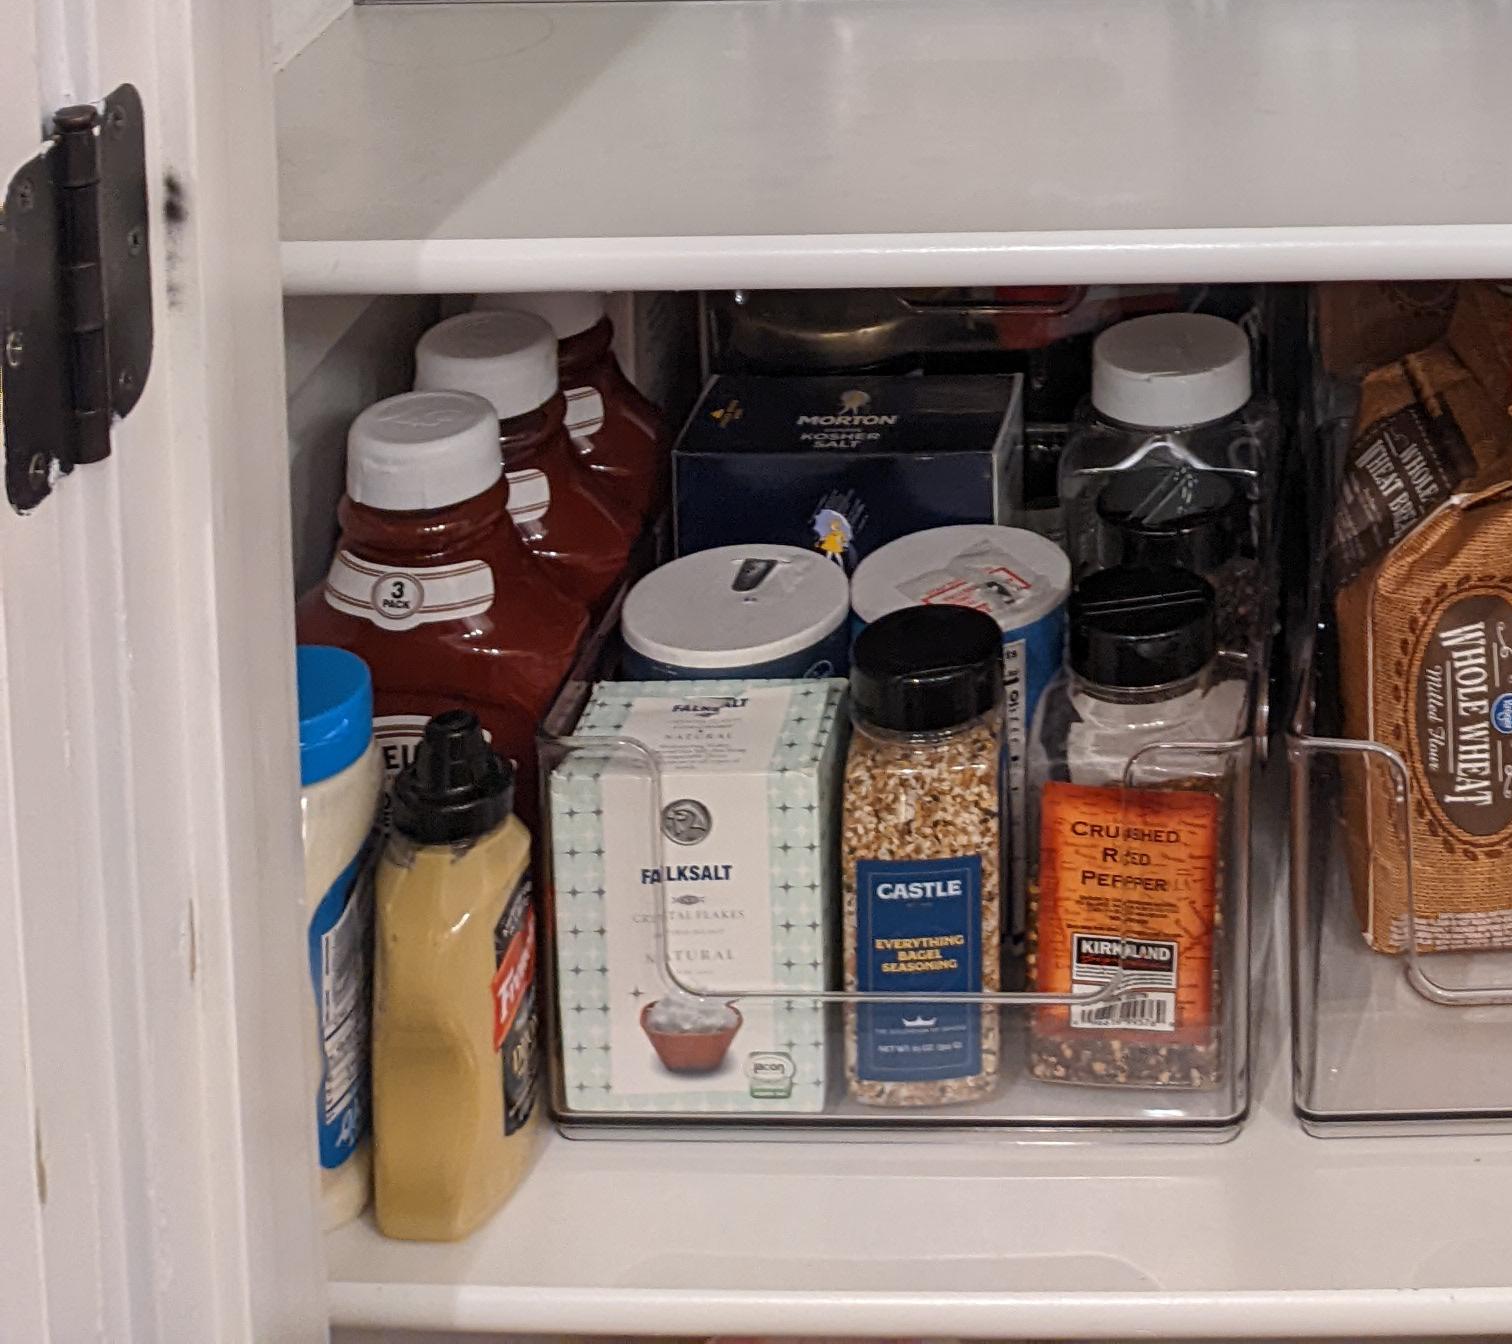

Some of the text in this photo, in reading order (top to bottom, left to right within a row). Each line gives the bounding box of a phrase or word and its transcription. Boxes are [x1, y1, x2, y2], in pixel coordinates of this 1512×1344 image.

[796, 415, 899, 425] MORTON
[799, 432, 881, 441] KOSHER
[813, 440, 861, 448] SALT
[390, 581, 406, 600] 3
[382, 598, 411, 611] PACK
[1424, 664, 1444, 724] Milled
[1438, 620, 1494, 807] WHOLE WHEAT
[1070, 821, 1181, 844] CRUSHED
[640, 864, 733, 885] FALKSALT
[876, 880, 963, 900] CASTLE
[874, 934, 964, 950] EVERYTHING
[1080, 939, 1172, 962] KIRKLAND
[897, 949, 943, 961] BAGEL
[880, 959, 958, 973] SEASONING
